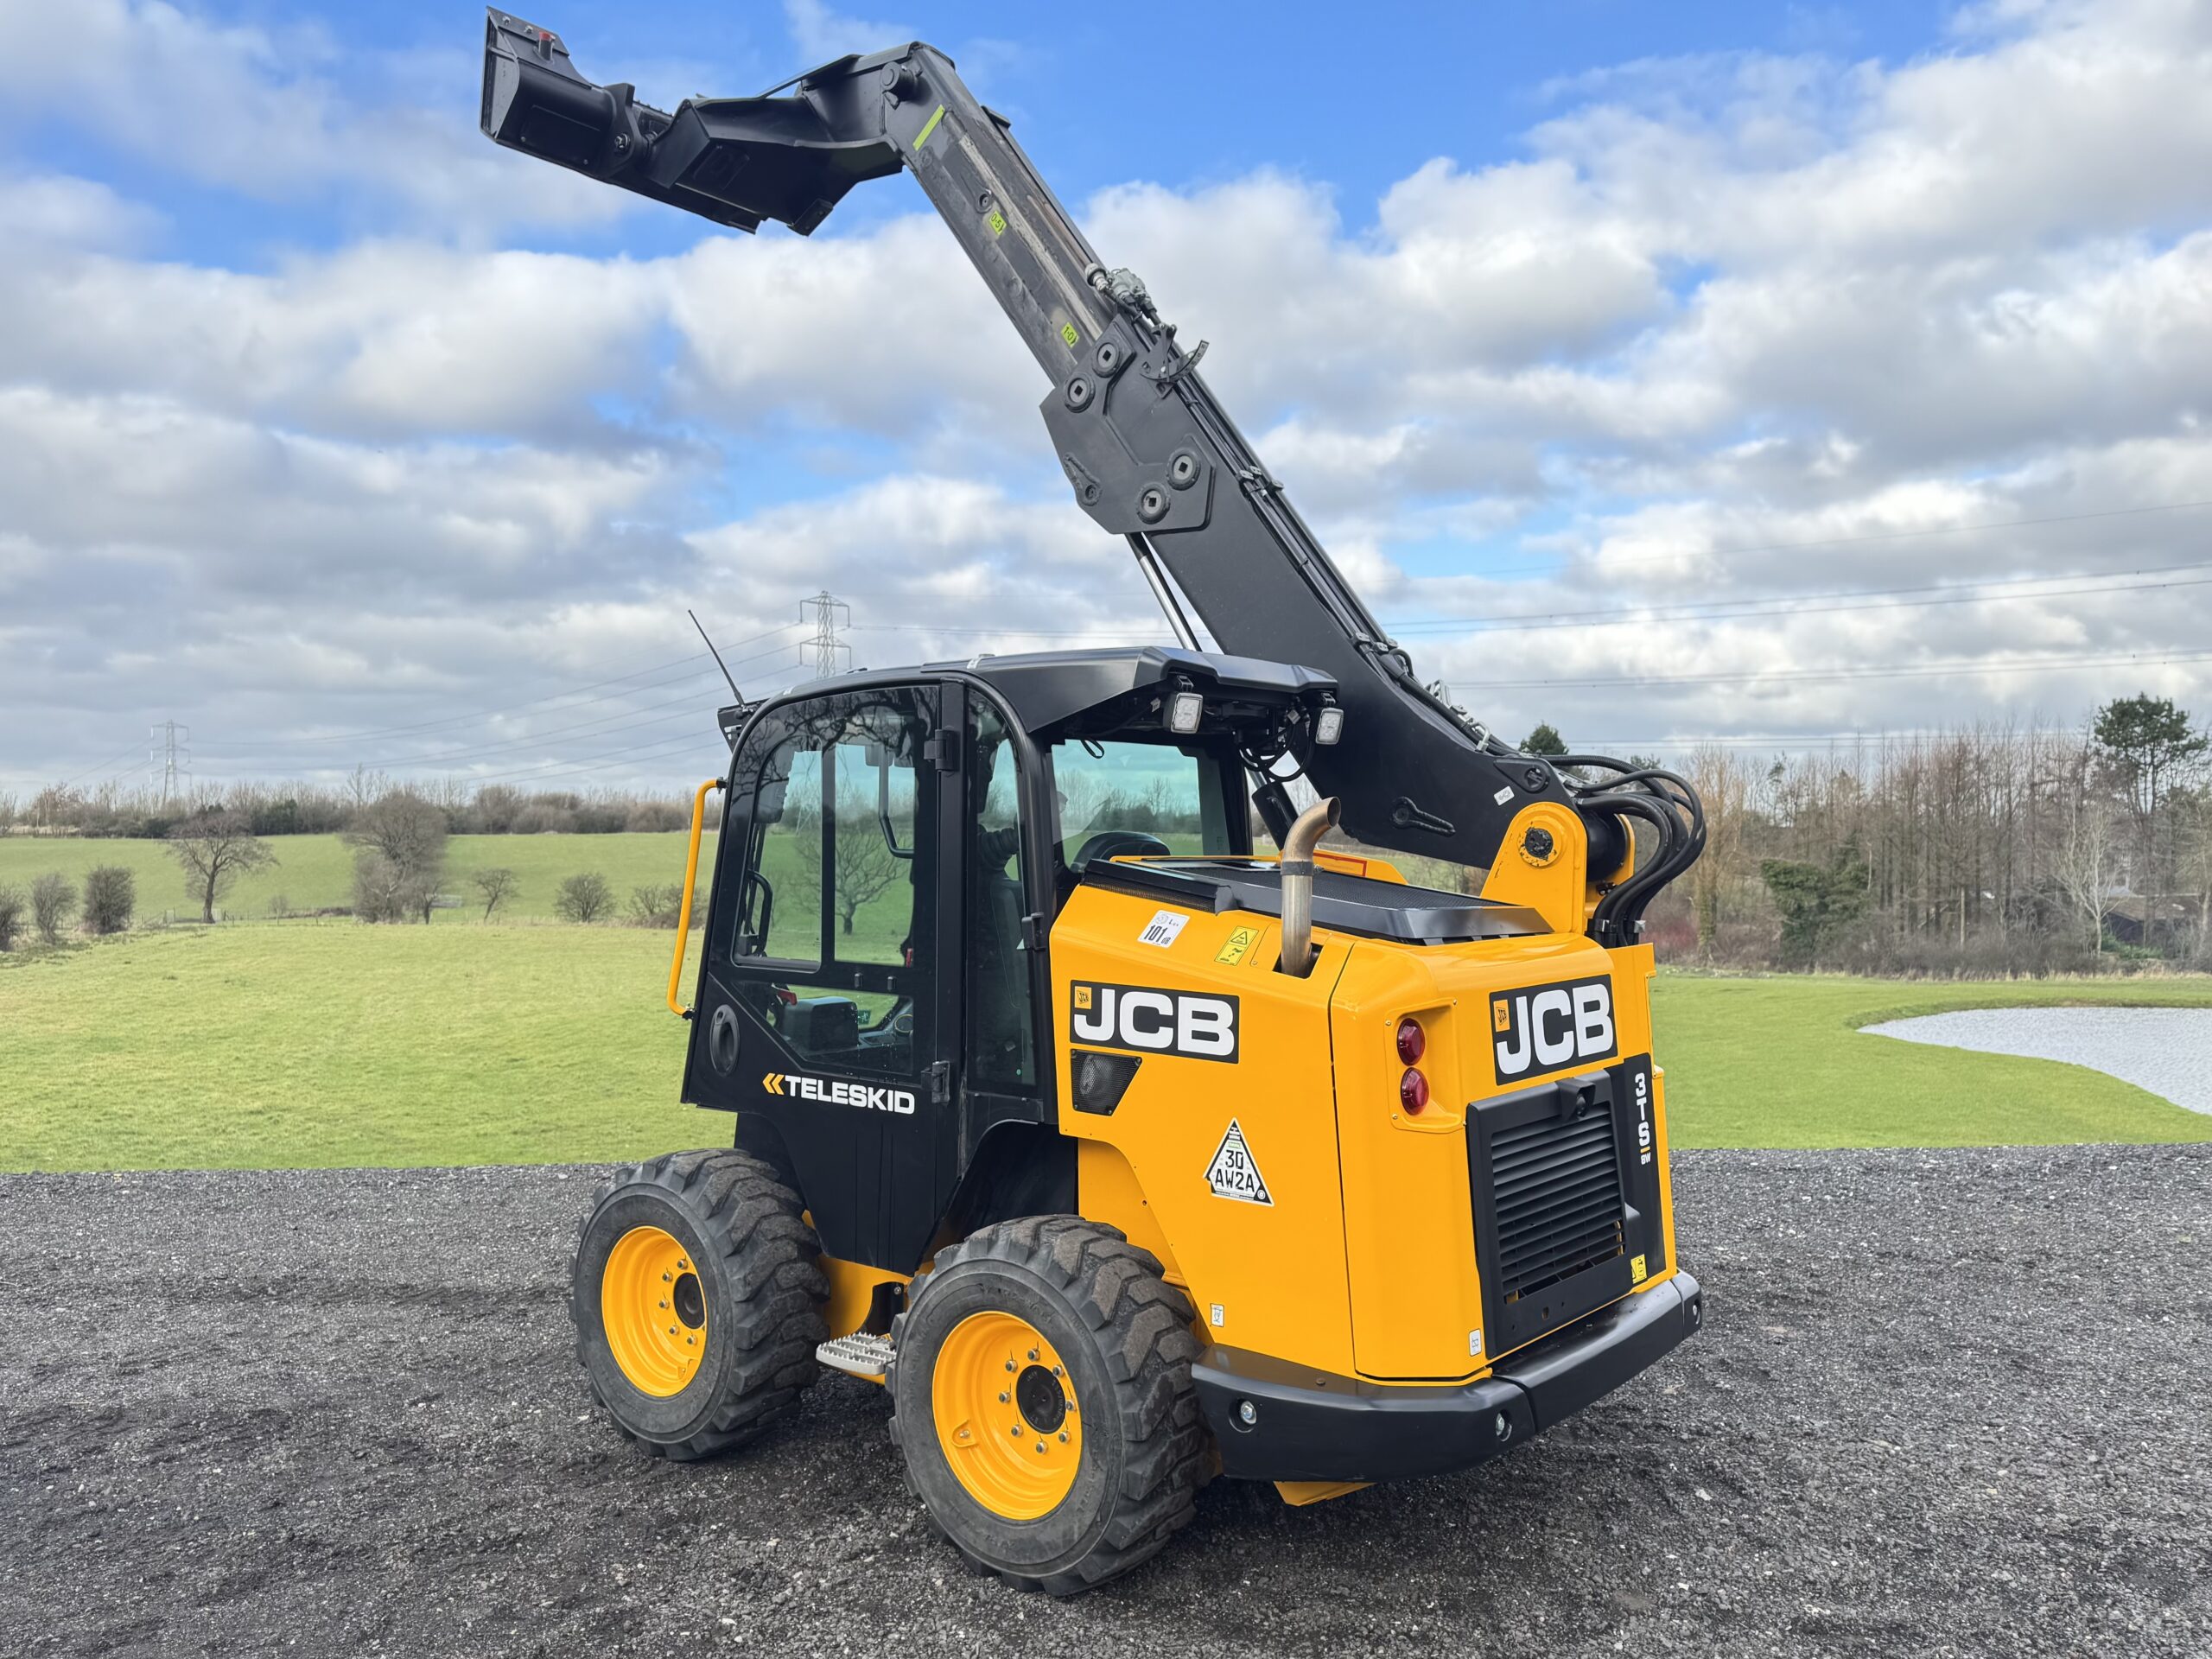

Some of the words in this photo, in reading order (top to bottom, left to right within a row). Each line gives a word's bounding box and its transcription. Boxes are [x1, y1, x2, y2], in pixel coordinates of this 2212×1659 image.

[1143, 925, 1168, 943] 101
[1074, 988, 1235, 1056] JCB
[1496, 983, 1614, 1075] JCB
[785, 1074, 915, 1115] TELESKID
[1215, 1168, 1255, 1192] AW2A
